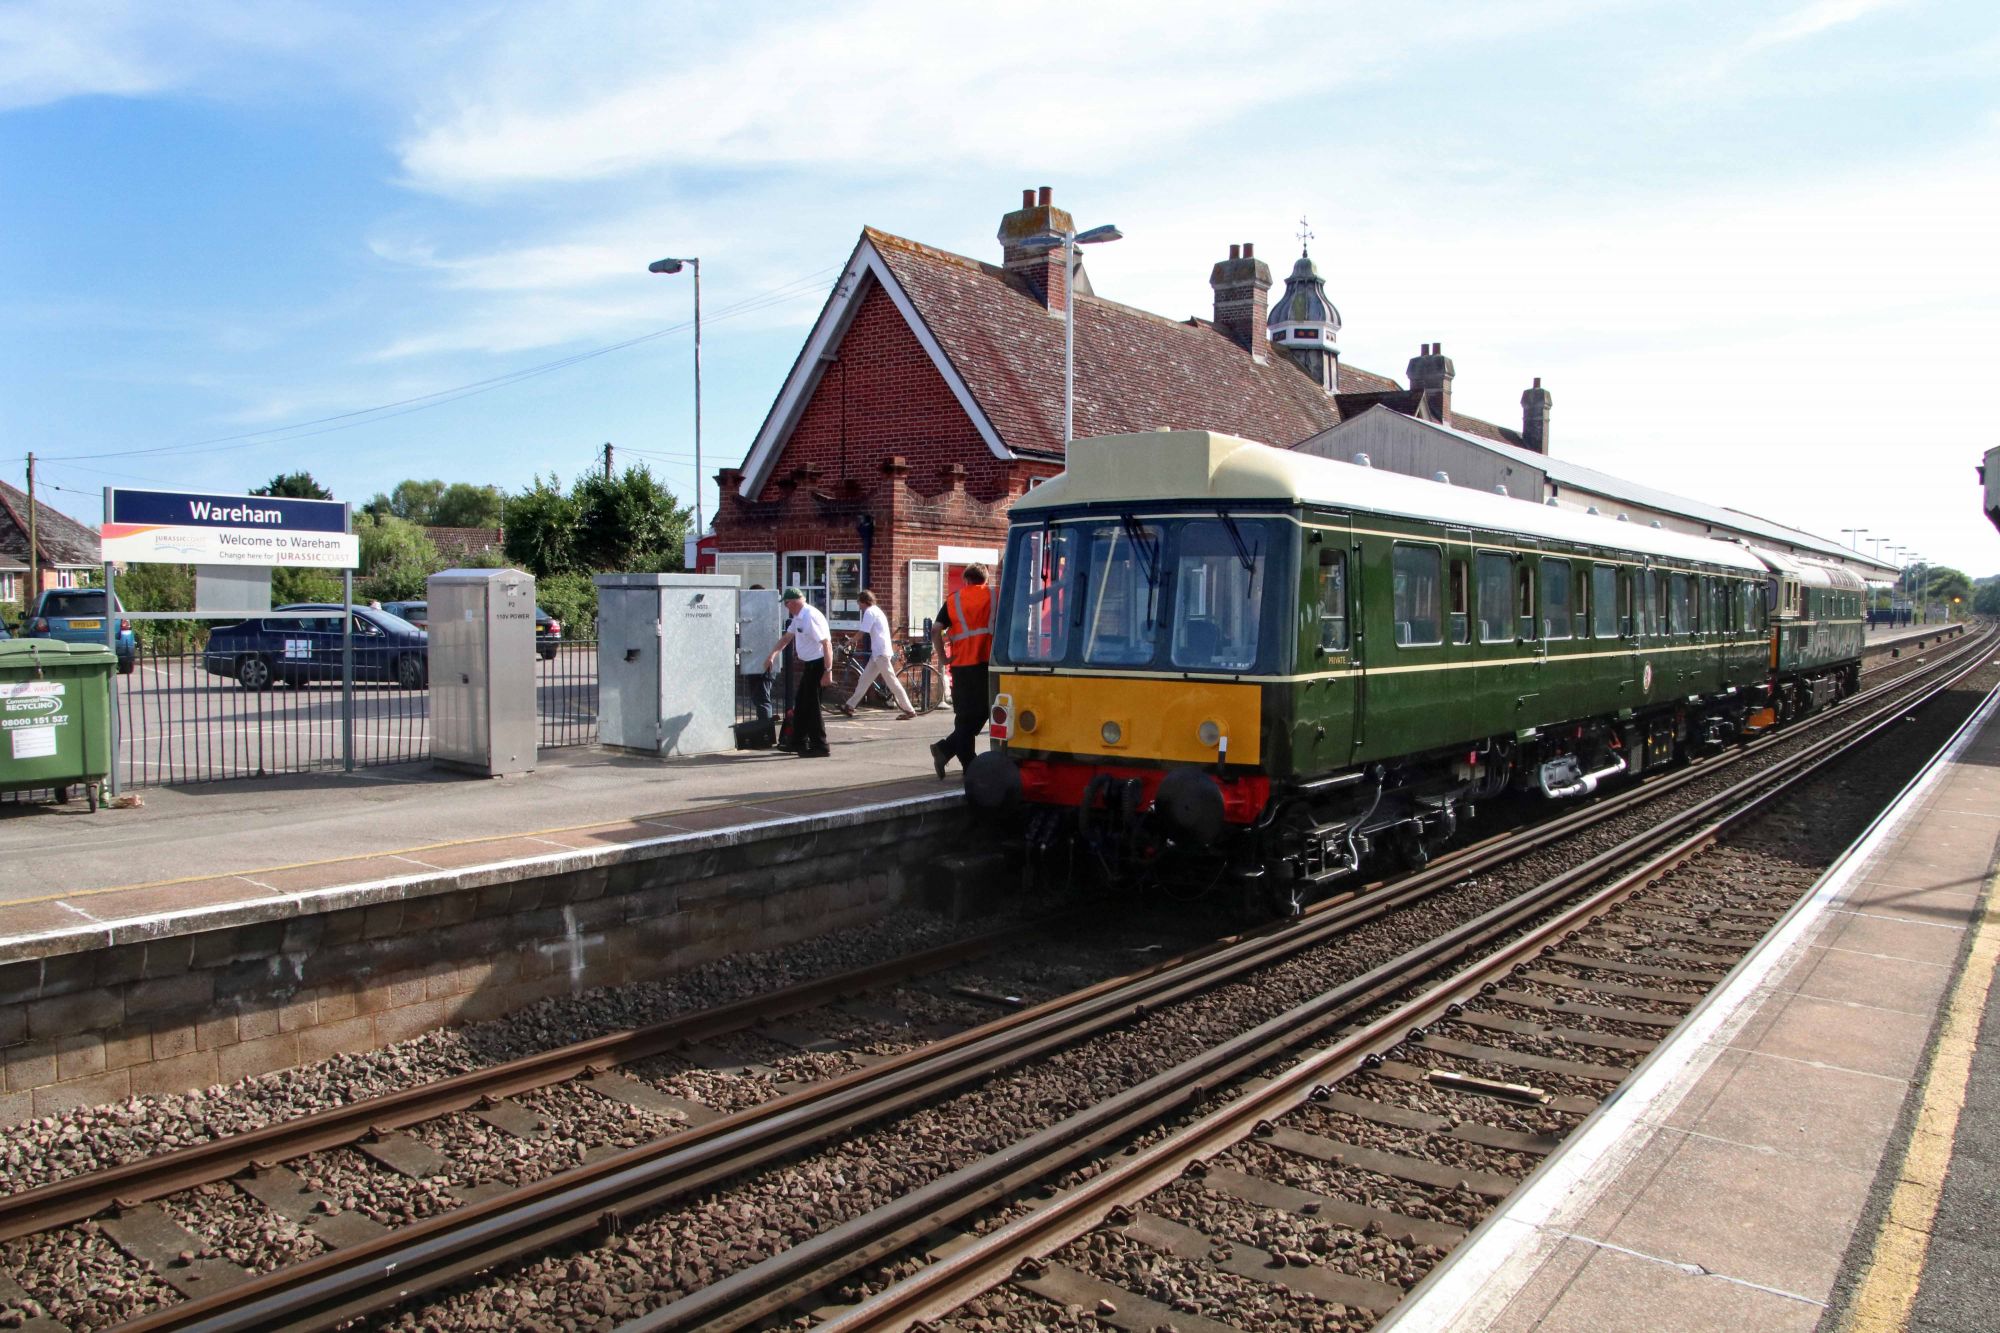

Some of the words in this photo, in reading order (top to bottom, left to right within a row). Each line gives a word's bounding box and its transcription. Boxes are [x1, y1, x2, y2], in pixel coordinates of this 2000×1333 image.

[189, 501, 282, 524] Wareham
[219, 534, 273, 547] Welcome
[276, 537, 287, 547] to
[290, 537, 341, 549] Wareham
[219, 552, 246, 561] Change
[1328, 656, 1346, 664] PRIVATE
[6, 702, 53, 711] RECYCLING
[52, 715, 69, 723] 527
